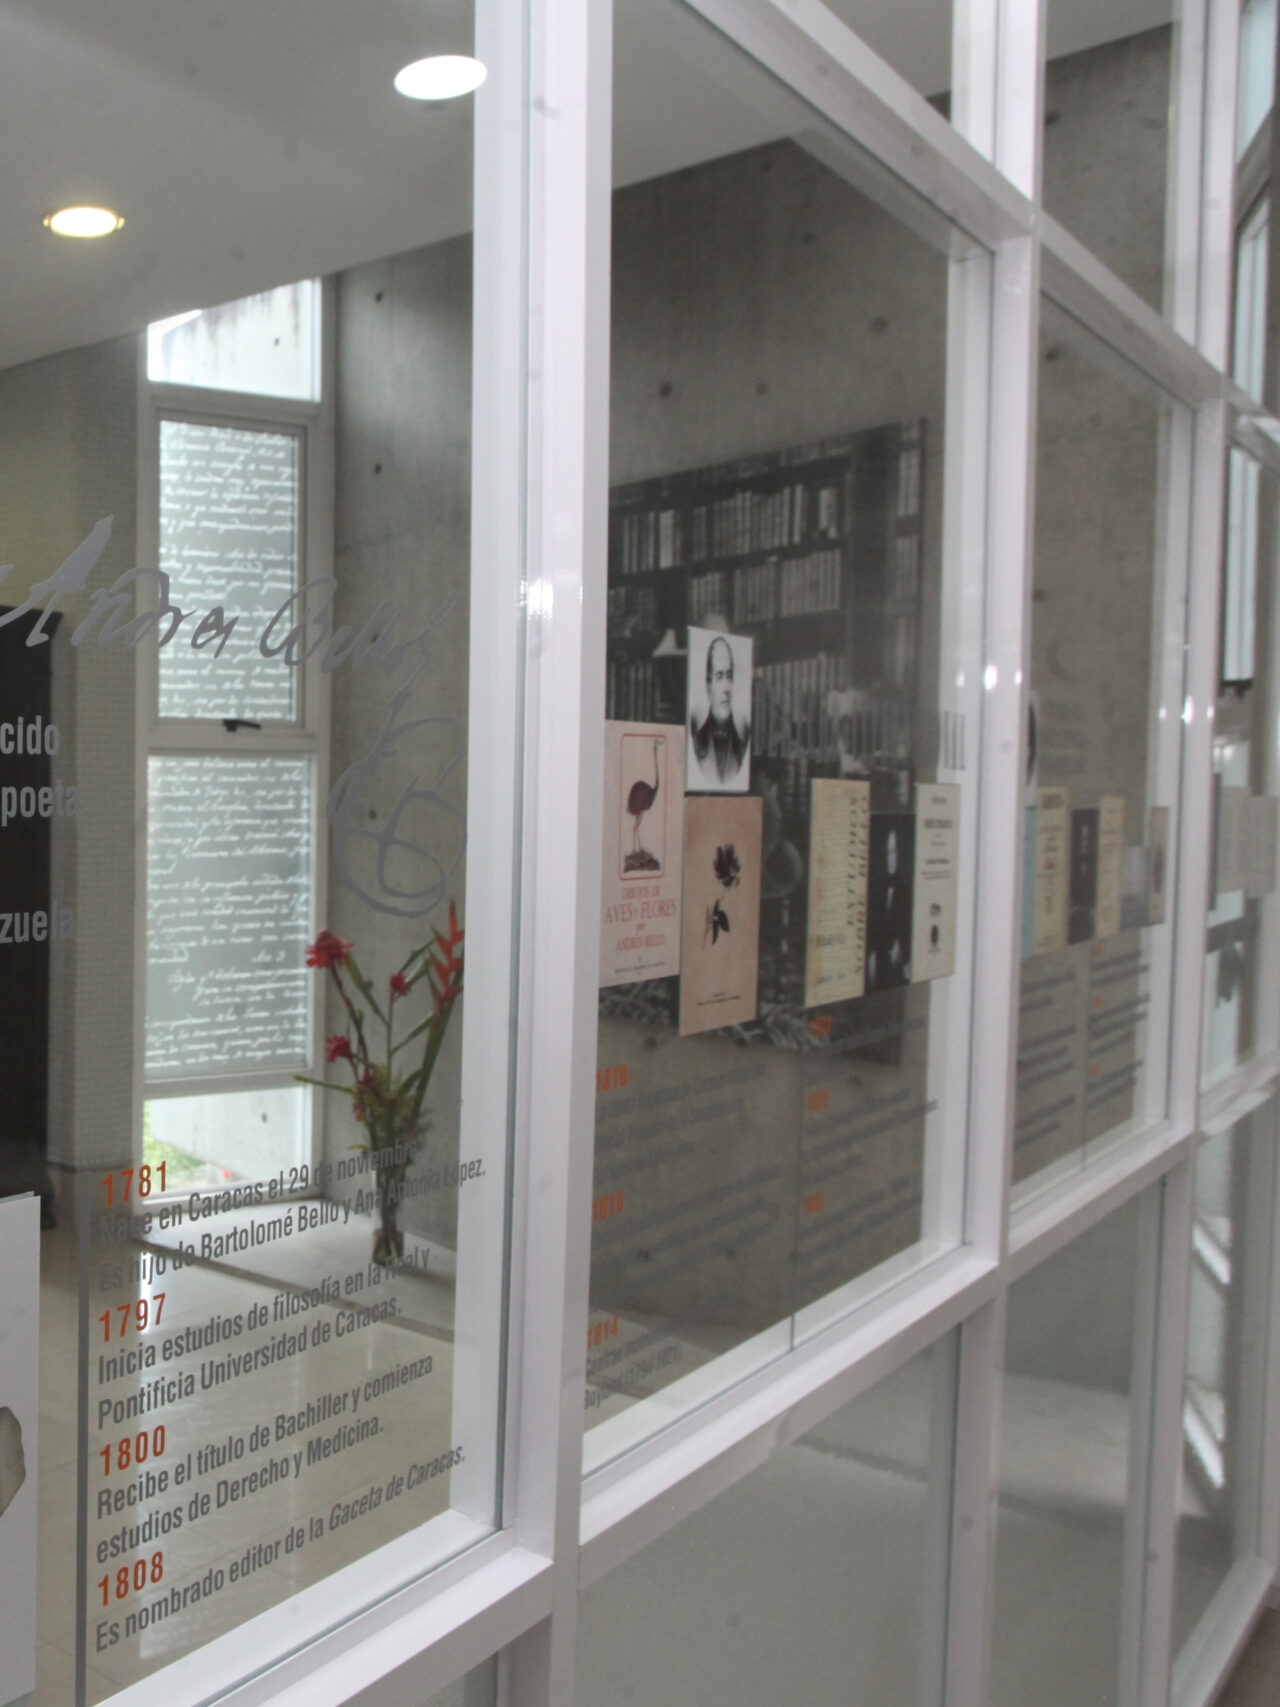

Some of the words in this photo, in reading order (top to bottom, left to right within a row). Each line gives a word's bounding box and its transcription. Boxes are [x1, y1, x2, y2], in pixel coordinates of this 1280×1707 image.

[604, 903, 633, 924] AVES
[640, 898, 677, 920] FLORES
[100, 1262, 123, 1292] Es
[130, 1251, 167, 1285] hijo
[172, 1241, 195, 1271] de
[201, 1207, 294, 1262] Bartolomé
[298, 1198, 339, 1232] Bello
[342, 1198, 352, 1225] y
[355, 1186, 383, 1215] Ana
[387, 1169, 441, 1202] Antonia
[102, 1160, 167, 1206] 1781
[158, 1203, 183, 1231] en
[188, 1184, 264, 1222] Caracas
[268, 1174, 285, 1200] el
[289, 1163, 310, 1195] 29
[313, 1157, 333, 1184] de
[98, 1342, 157, 1385] Inicia
[162, 1313, 243, 1361] estudios
[247, 1301, 269, 1332] de
[273, 1276, 341, 1322] filosofía
[344, 1270, 363, 1296] en
[367, 1263, 380, 1287] la
[421, 1247, 431, 1272] y
[98, 1371, 195, 1430] Pontificia
[200, 1335, 307, 1391] Universidad
[312, 1320, 332, 1348] de
[335, 1297, 402, 1339] Caracas.
[99, 1293, 166, 1342] 1797
[97, 1469, 169, 1520] Recibe
[174, 1454, 192, 1486] el
[196, 1435, 245, 1476] título
[249, 1423, 270, 1454] de
[275, 1390, 348, 1442] Bachiller
[350, 1388, 360, 1414] y
[363, 1353, 433, 1397] comienza
[99, 1424, 166, 1477] 1800
[97, 1506, 183, 1564] estudios
[187, 1490, 211, 1522] de
[215, 1456, 290, 1509] Derecho
[293, 1450, 304, 1479] y
[306, 1415, 384, 1467] Medicina.
[96, 1619, 120, 1653] Es
[125, 1567, 225, 1639] nombrado
[229, 1538, 282, 1584] editor
[284, 1525, 305, 1555] de
[308, 1514, 324, 1540] la
[328, 1487, 383, 1531] Gaceta
[385, 1474, 405, 1501] de
[407, 1445, 466, 1490] Caracas.
[98, 1551, 164, 1607] 1808
